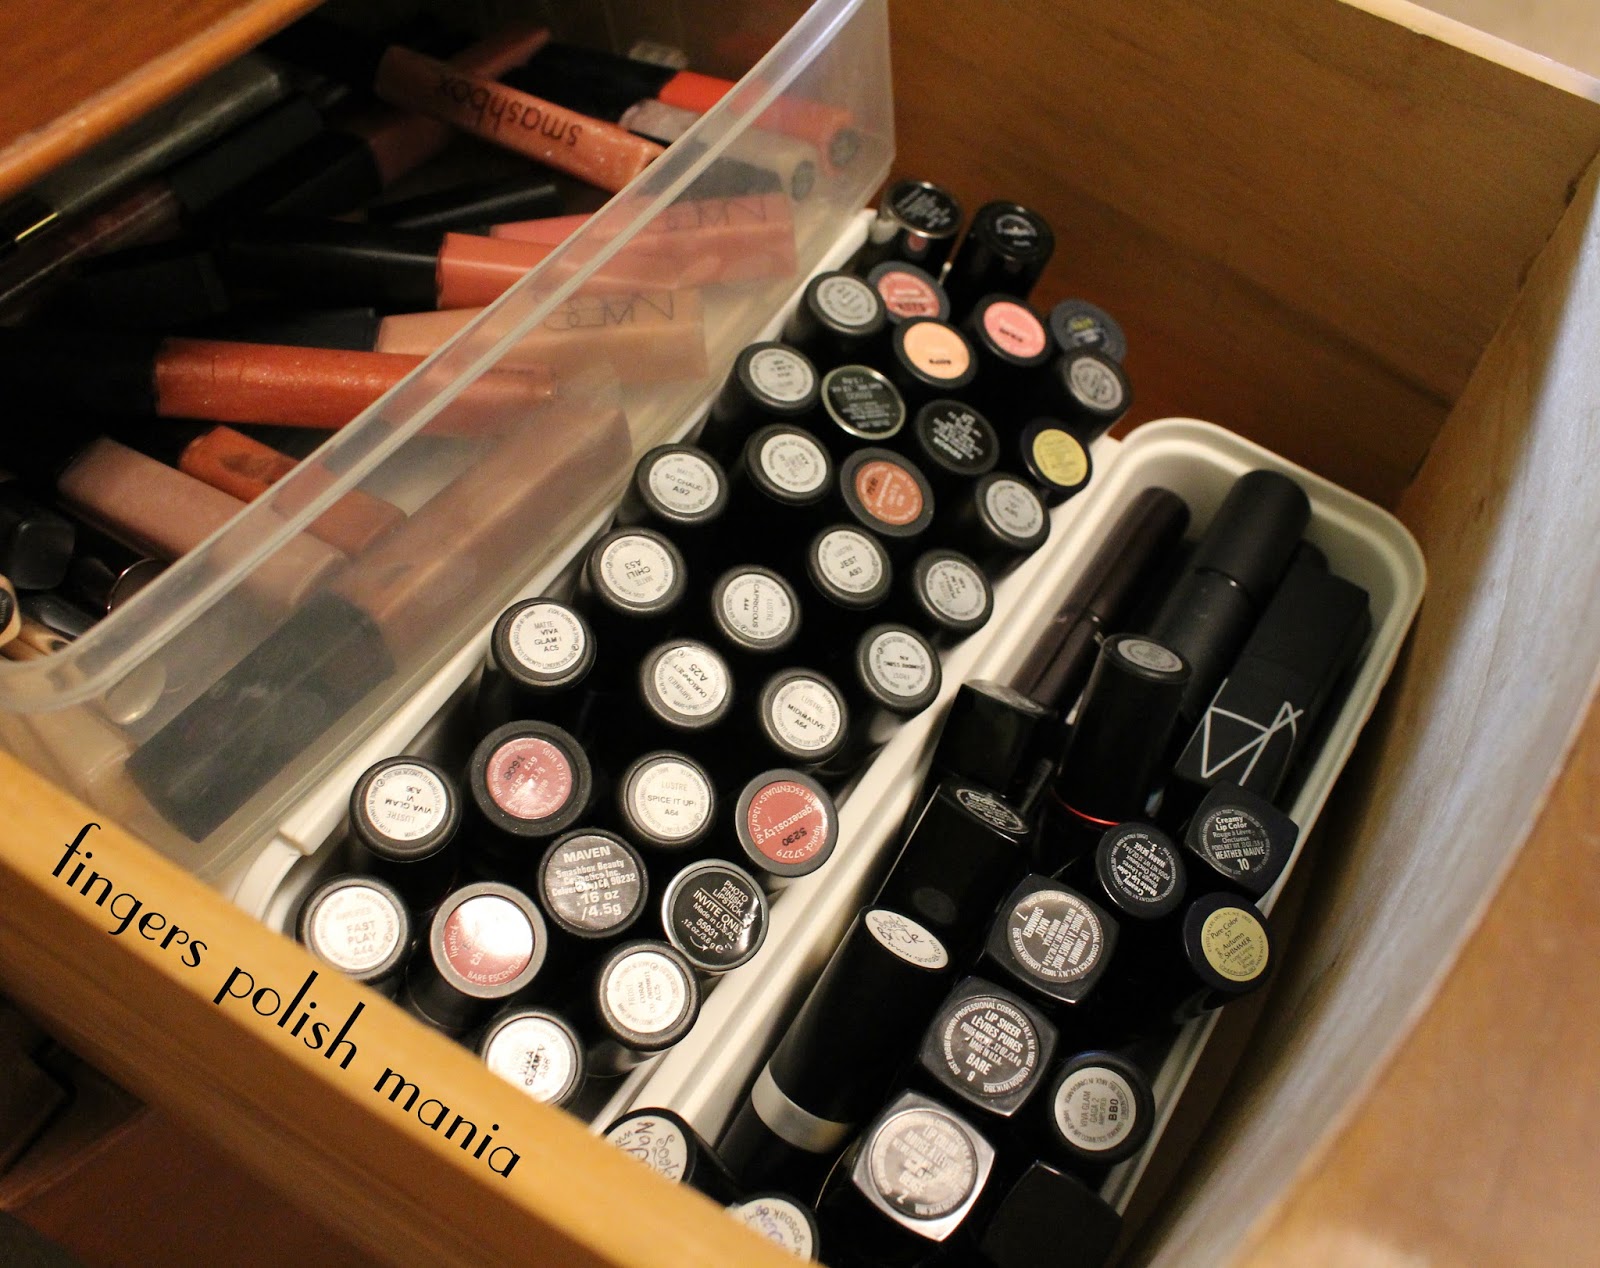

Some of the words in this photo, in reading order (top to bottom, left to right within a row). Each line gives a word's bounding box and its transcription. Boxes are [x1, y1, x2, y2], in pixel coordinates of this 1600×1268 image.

[437, 74, 584, 148] smashbox
[840, 556, 857, 569] JEST
[626, 565, 651, 579] CHILI
[752, 583, 760, 628] CAPRICIOUS
[540, 628, 559, 636] VIVA
[534, 637, 557, 646] GLAM
[688, 663, 709, 682] A25
[661, 781, 688, 791] LUSTRE
[385, 798, 410, 809] GLAM
[647, 795, 671, 804] SPICE
[673, 797, 682, 805] IT
[387, 810, 415, 824] LUSTRE
[413, 805, 432, 813] VIVA
[762, 803, 814, 840] generosity
[1215, 814, 1243, 826] Creamy
[1215, 823, 1227, 831] Lip
[1227, 821, 1247, 830] Color
[782, 827, 807, 847] 5230
[803, 825, 824, 853] lipstick
[1212, 830, 1231, 838] Rouge
[1222, 836, 1250, 844] Onctueux
[563, 845, 611, 863] MAVEN
[775, 844, 806, 861] 37279
[1134, 842, 1150, 857] BEIGE
[1215, 849, 1243, 859] HEATHER
[1243, 846, 1265, 856] MAUVE
[1148, 853, 1166, 868] WARM
[1237, 858, 1250, 870] 10
[556, 865, 596, 879] Smashbox
[597, 860, 625, 872] Beauty
[605, 869, 621, 878] Inc.
[1114, 865, 1132, 879] Color
[1148, 871, 1160, 882] Mat
[611, 873, 637, 886] 90232
[1121, 877, 1144, 896] Creamy
[1131, 874, 1141, 885] Lip
[1141, 874, 1158, 889] Rouge
[724, 879, 749, 903] PHOTO
[1140, 881, 1157, 896] Matte
[576, 891, 600, 906] .16
[604, 890, 620, 900] oz
[693, 890, 721, 918] INVITE
[712, 888, 743, 916] LIPSTICK
[720, 887, 744, 909] FINISH
[1058, 894, 1081, 908] BROWN
[581, 903, 622, 921] /4.5g
[692, 902, 709, 916] Made
[347, 921, 375, 933] FAST
[681, 918, 691, 929] .12
[695, 918, 719, 940] 55931
[1022, 907, 1044, 938] SHIMMER
[1035, 917, 1050, 937] MALT
[1078, 903, 1100, 944] PROFESSIONAL
[1210, 928, 1224, 939] Pure
[1222, 917, 1238, 930] Color
[348, 932, 377, 944] PLAY
[448, 923, 462, 958] lipstick
[1080, 929, 1091, 941] LIP
[1223, 932, 1245, 950] Autumn
[1068, 938, 1086, 965] SHIMMER
[1224, 937, 1251, 958] SHIMMER
[1019, 950, 1042, 972] LONDON
[1078, 943, 1100, 972] COSMETICS
[466, 969, 486, 983] BARE
[954, 1001, 996, 1021] PROFESSIONAL
[996, 1003, 1029, 1028] COSMETICS
[944, 1017, 960, 1040] BROWN
[984, 1010, 999, 1022] LIP
[997, 1018, 1021, 1038] SHEER
[971, 1015, 1000, 1038] LÈVRES
[998, 1032, 1023, 1053] PURES
[944, 1040, 954, 1060] BOBBI
[969, 1039, 984, 1053] MADE
[948, 1059, 961, 1075] DIST.
[966, 1053, 991, 1075] BARE
[967, 1071, 976, 1081] 9
[1009, 1066, 1031, 1087] LONDON
[1082, 1091, 1091, 1111] GLAM
